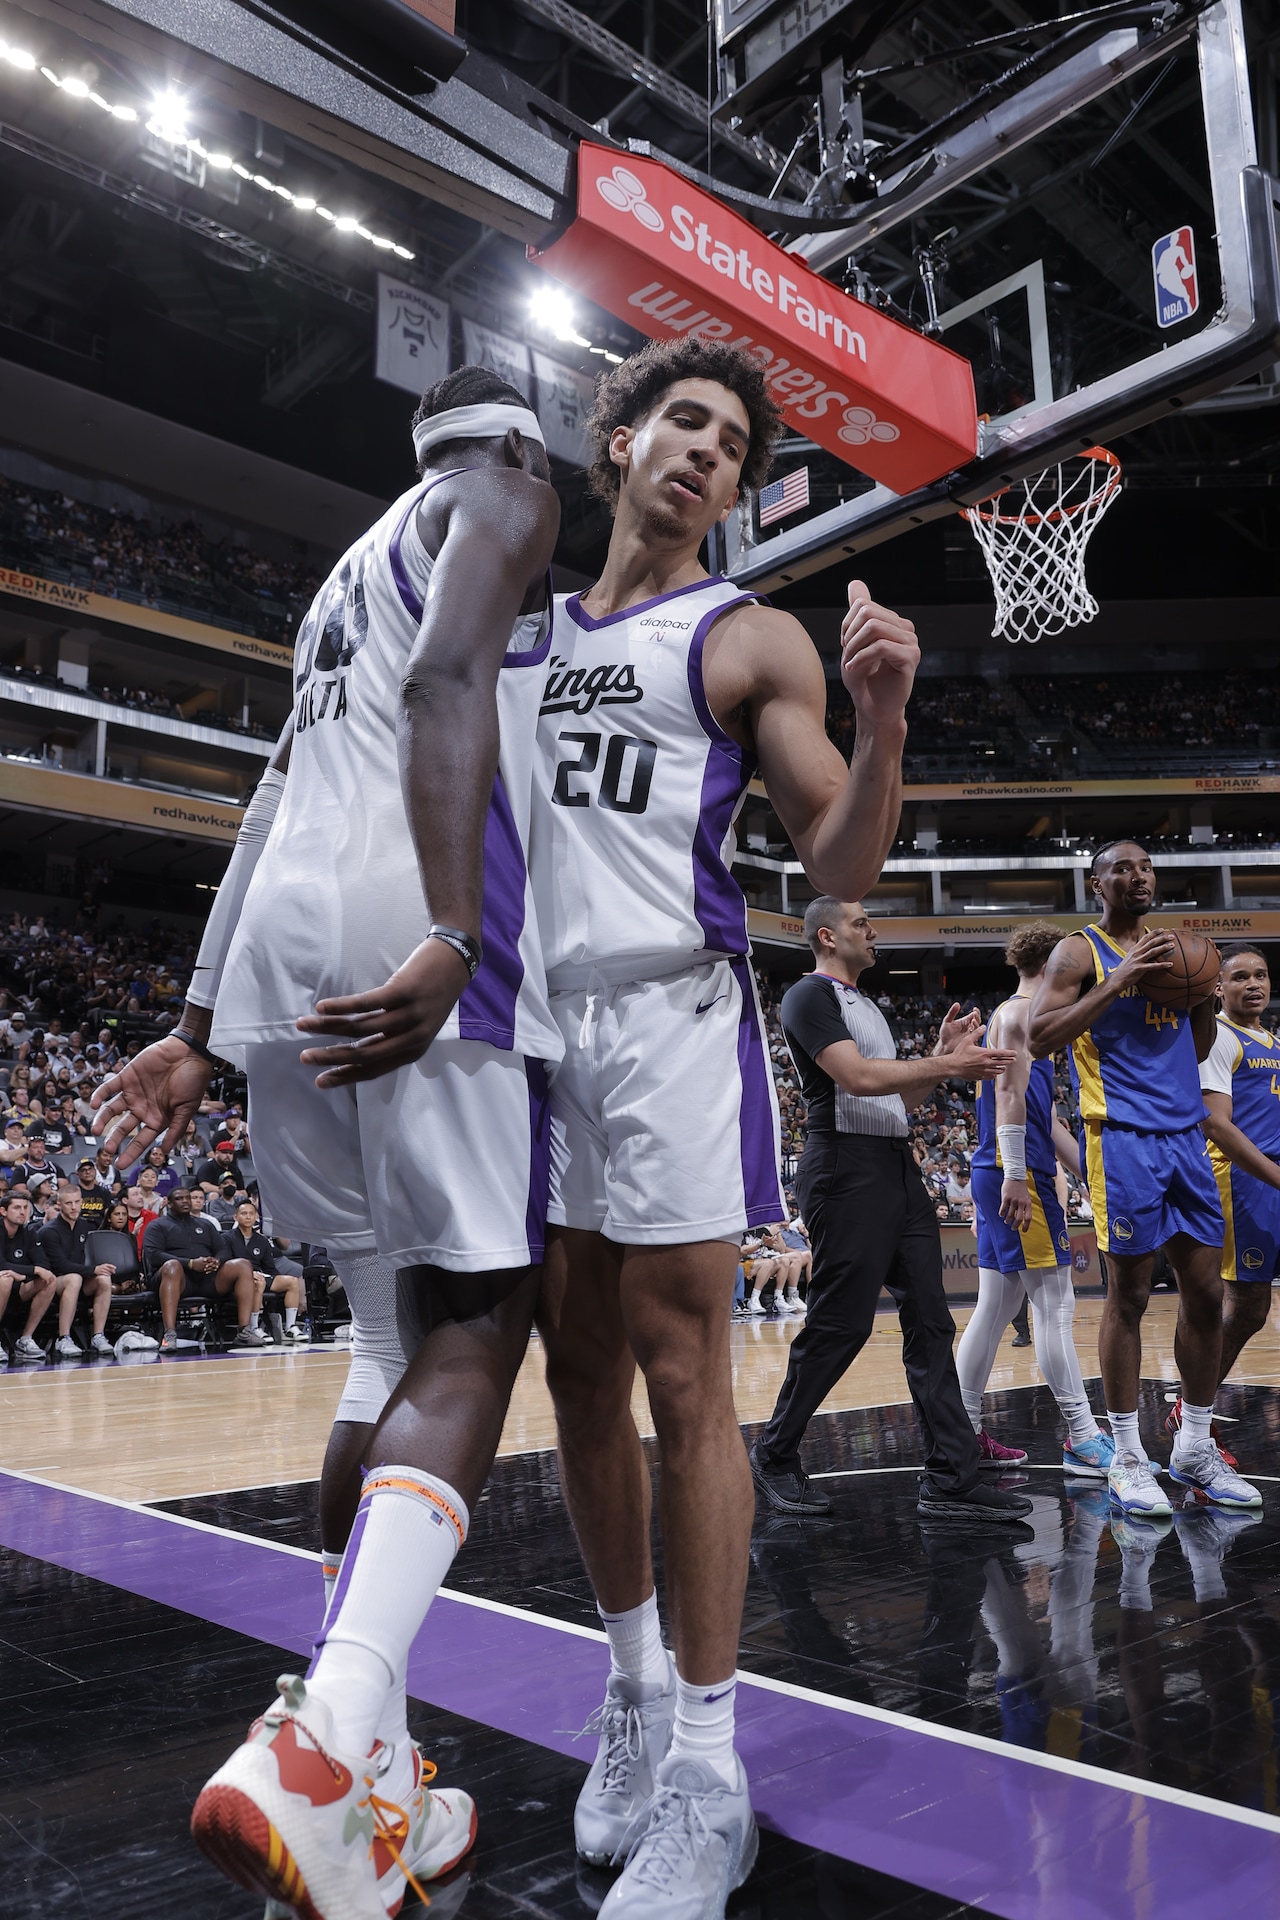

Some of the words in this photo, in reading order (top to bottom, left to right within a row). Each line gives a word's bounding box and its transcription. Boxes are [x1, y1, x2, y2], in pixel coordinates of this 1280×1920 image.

[1163, 300, 1183, 321] NBA
[409, 343, 418, 358] 2
[640, 617, 692, 630] dialpad
[551, 731, 658, 815] 20
[962, 785, 1072, 795] redhawkcasino.com
[1195, 778, 1261, 788] REDHAWK
[1183, 918, 1252, 928] REDHAWK
[1145, 1001, 1179, 1032] 44
